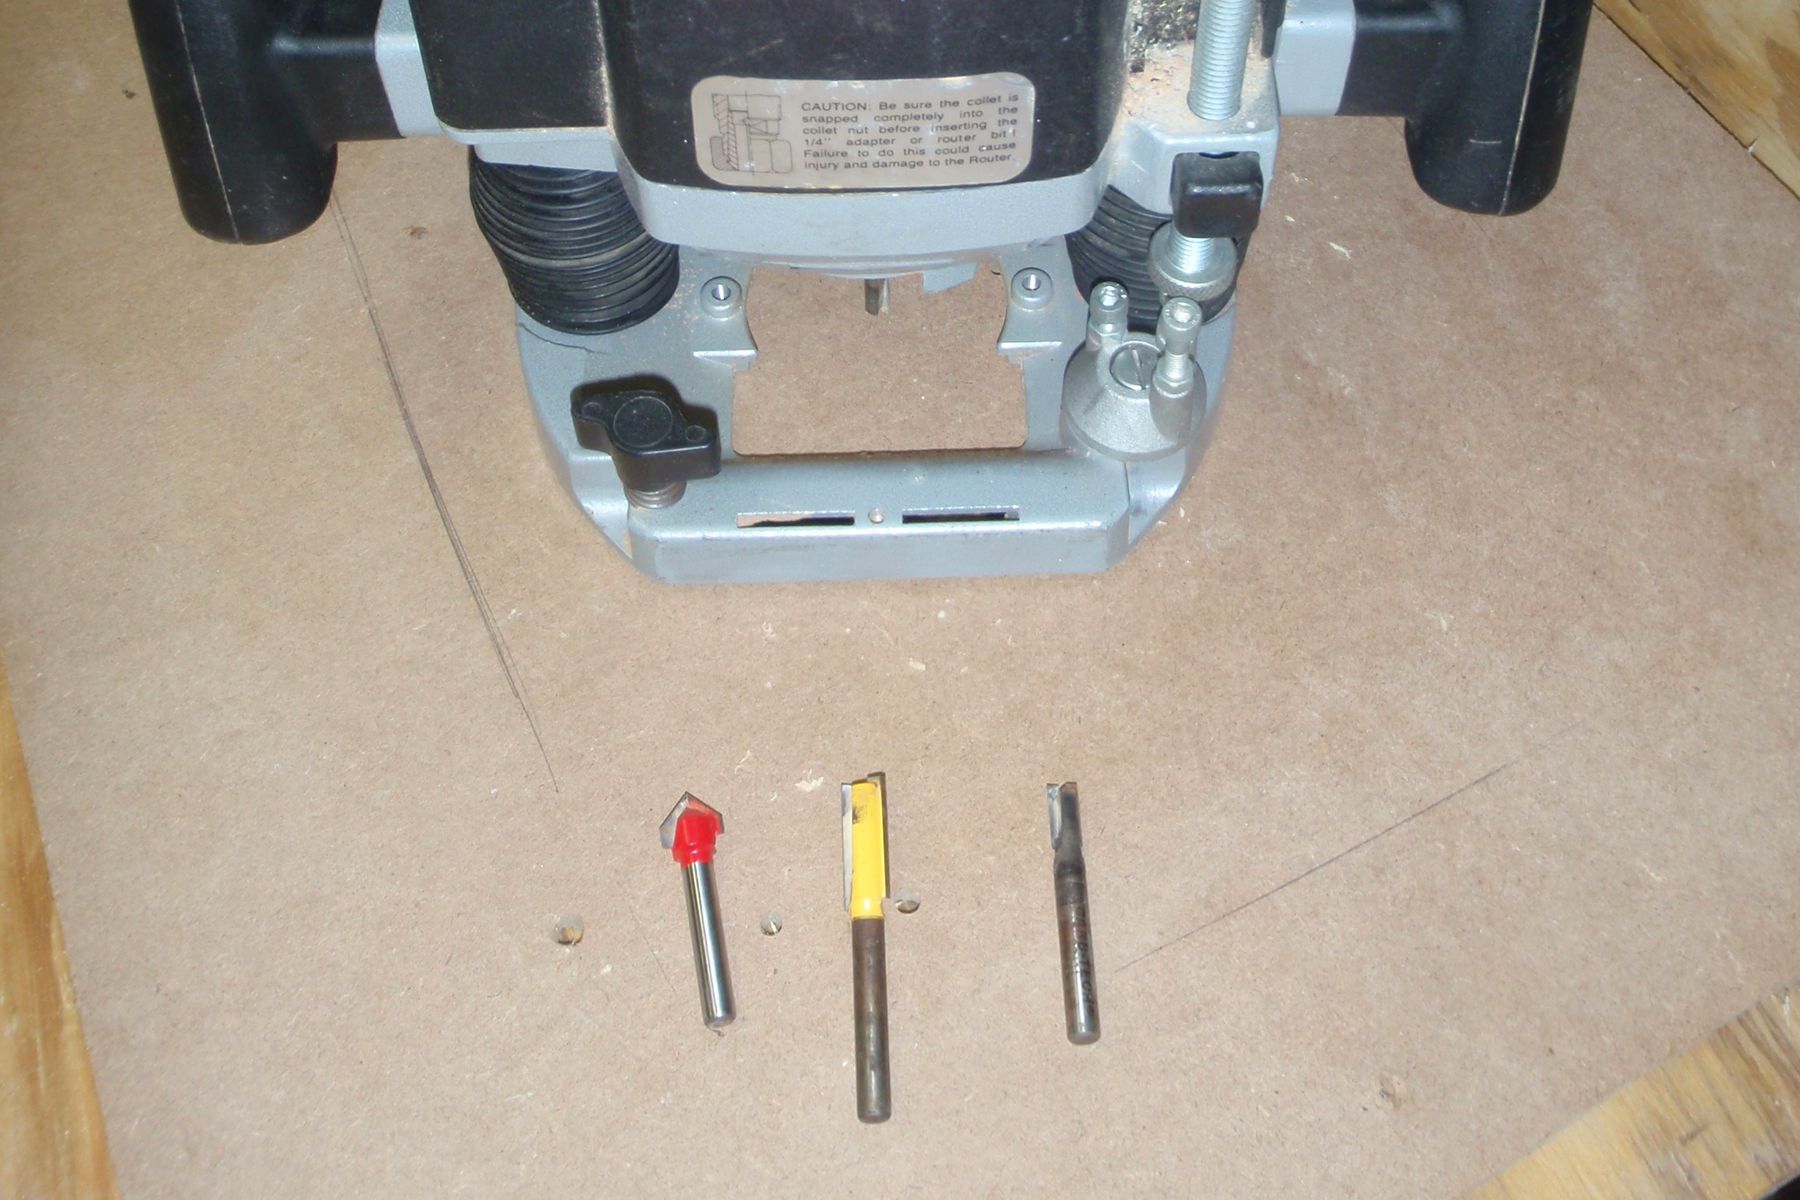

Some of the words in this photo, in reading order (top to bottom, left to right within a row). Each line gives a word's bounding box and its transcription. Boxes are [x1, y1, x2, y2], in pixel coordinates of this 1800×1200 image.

[801, 102, 871, 112] CAUTION:
[879, 102, 897, 111] Be
[903, 101, 932, 110] sure
[940, 99, 960, 108] the
[967, 95, 1002, 106] collet
[1008, 94, 1019, 102] is
[802, 115, 859, 124] snapped
[873, 112, 944, 123] completely
[960, 109, 984, 118] into
[998, 106, 1018, 115] the
[802, 126, 838, 135] collet
[848, 127, 869, 135] nut
[878, 125, 920, 134] before
[931, 121, 988, 132] inserting
[998, 118, 1018, 127] the
[846, 137, 897, 147] adapter
[910, 137, 923, 145] or
[937, 134, 977, 143] router
[803, 149, 848, 158] Failure
[857, 149, 870, 158] to
[878, 149, 895, 157] do
[903, 147, 926, 156] this
[934, 145, 970, 155] could
[978, 141, 1016, 152] cause
[804, 160, 840, 171] injury
[844, 160, 868, 169] and
[872, 159, 924, 170] damage
[928, 159, 941, 167] to
[945, 157, 965, 166] the
[969, 153, 1016, 165] Router.
